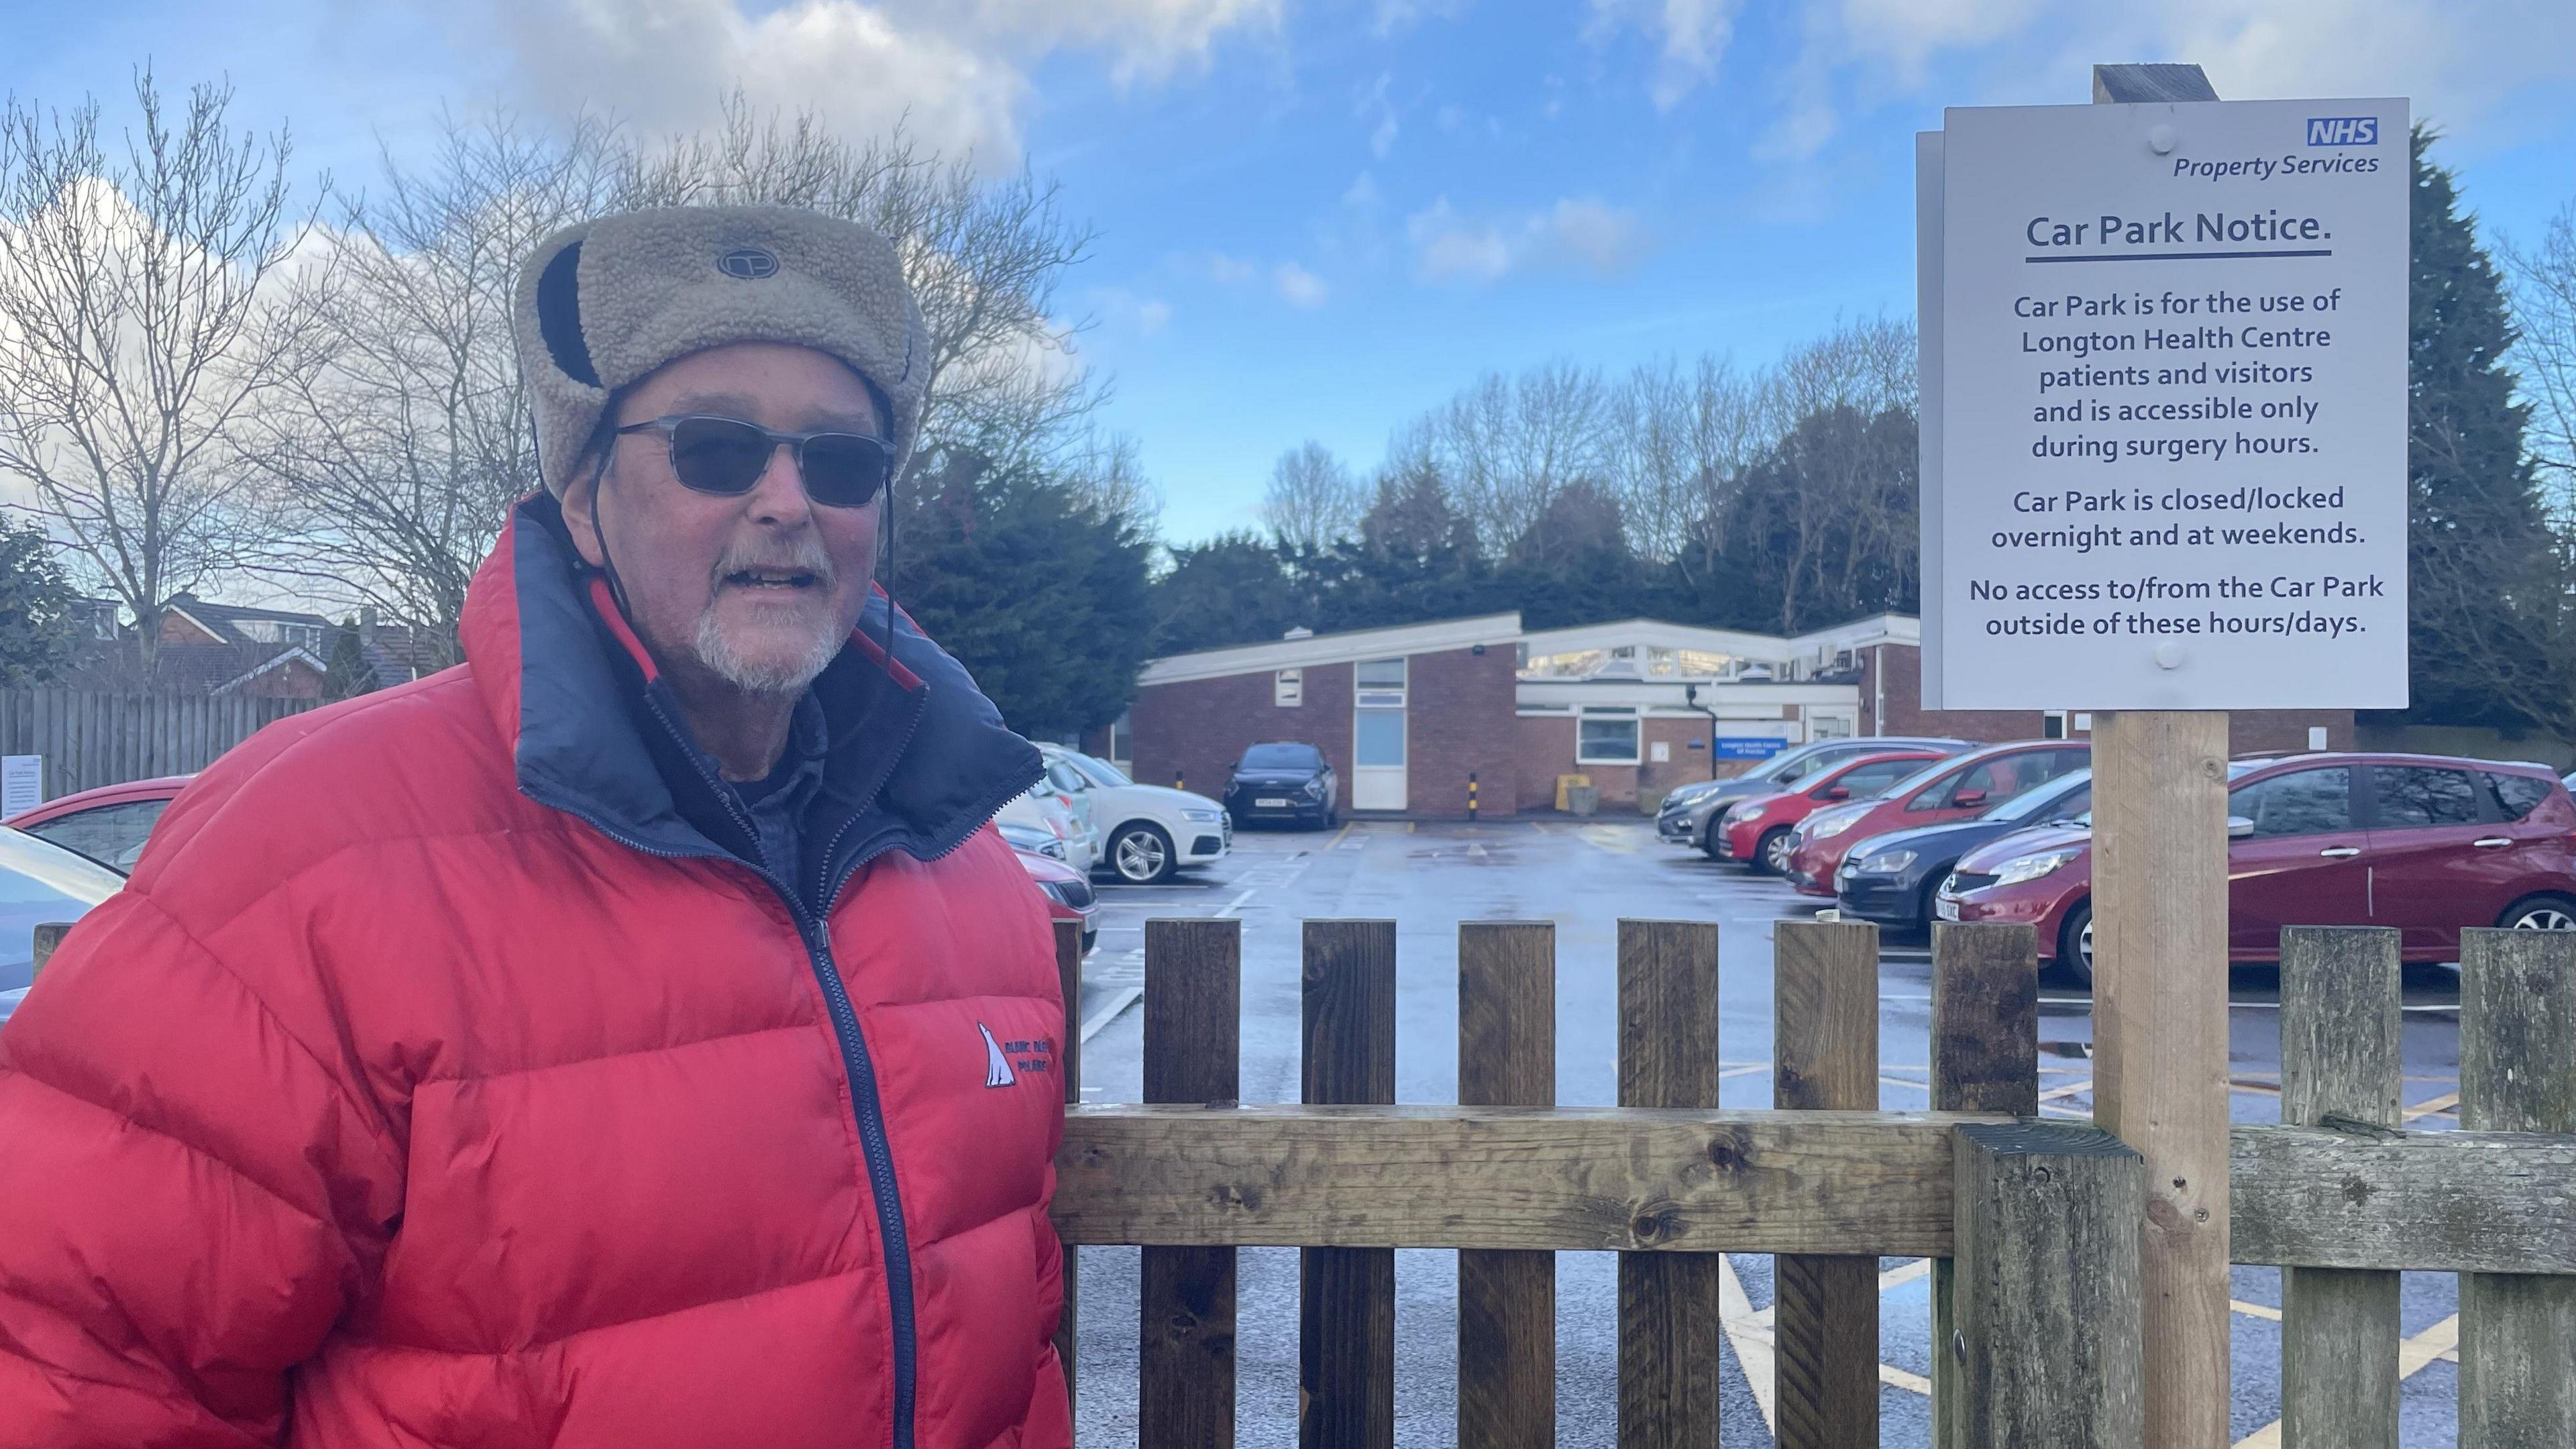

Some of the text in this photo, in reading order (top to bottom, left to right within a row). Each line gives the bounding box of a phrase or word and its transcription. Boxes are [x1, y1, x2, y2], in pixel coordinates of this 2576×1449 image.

[2309, 119, 2375, 144] NHS
[2174, 153, 2379, 182] Property Services
[2027, 210, 2330, 246] Car Park Notice.
[2015, 288, 2341, 317] Car Park is for the use of
[2023, 326, 2330, 358] Longton Health Centre
[2041, 361, 2312, 394] patients and visitors
[2034, 395, 2318, 424] and is accessible only
[2033, 432, 2318, 463] during surgery hours.
[2014, 486, 2343, 513] Car Park is closed/locked
[1992, 521, 2365, 553] overnight and at weekends.
[1971, 574, 2383, 602] No access to/from the Car Park
[1986, 610, 2365, 639] outside of these hours/days.
